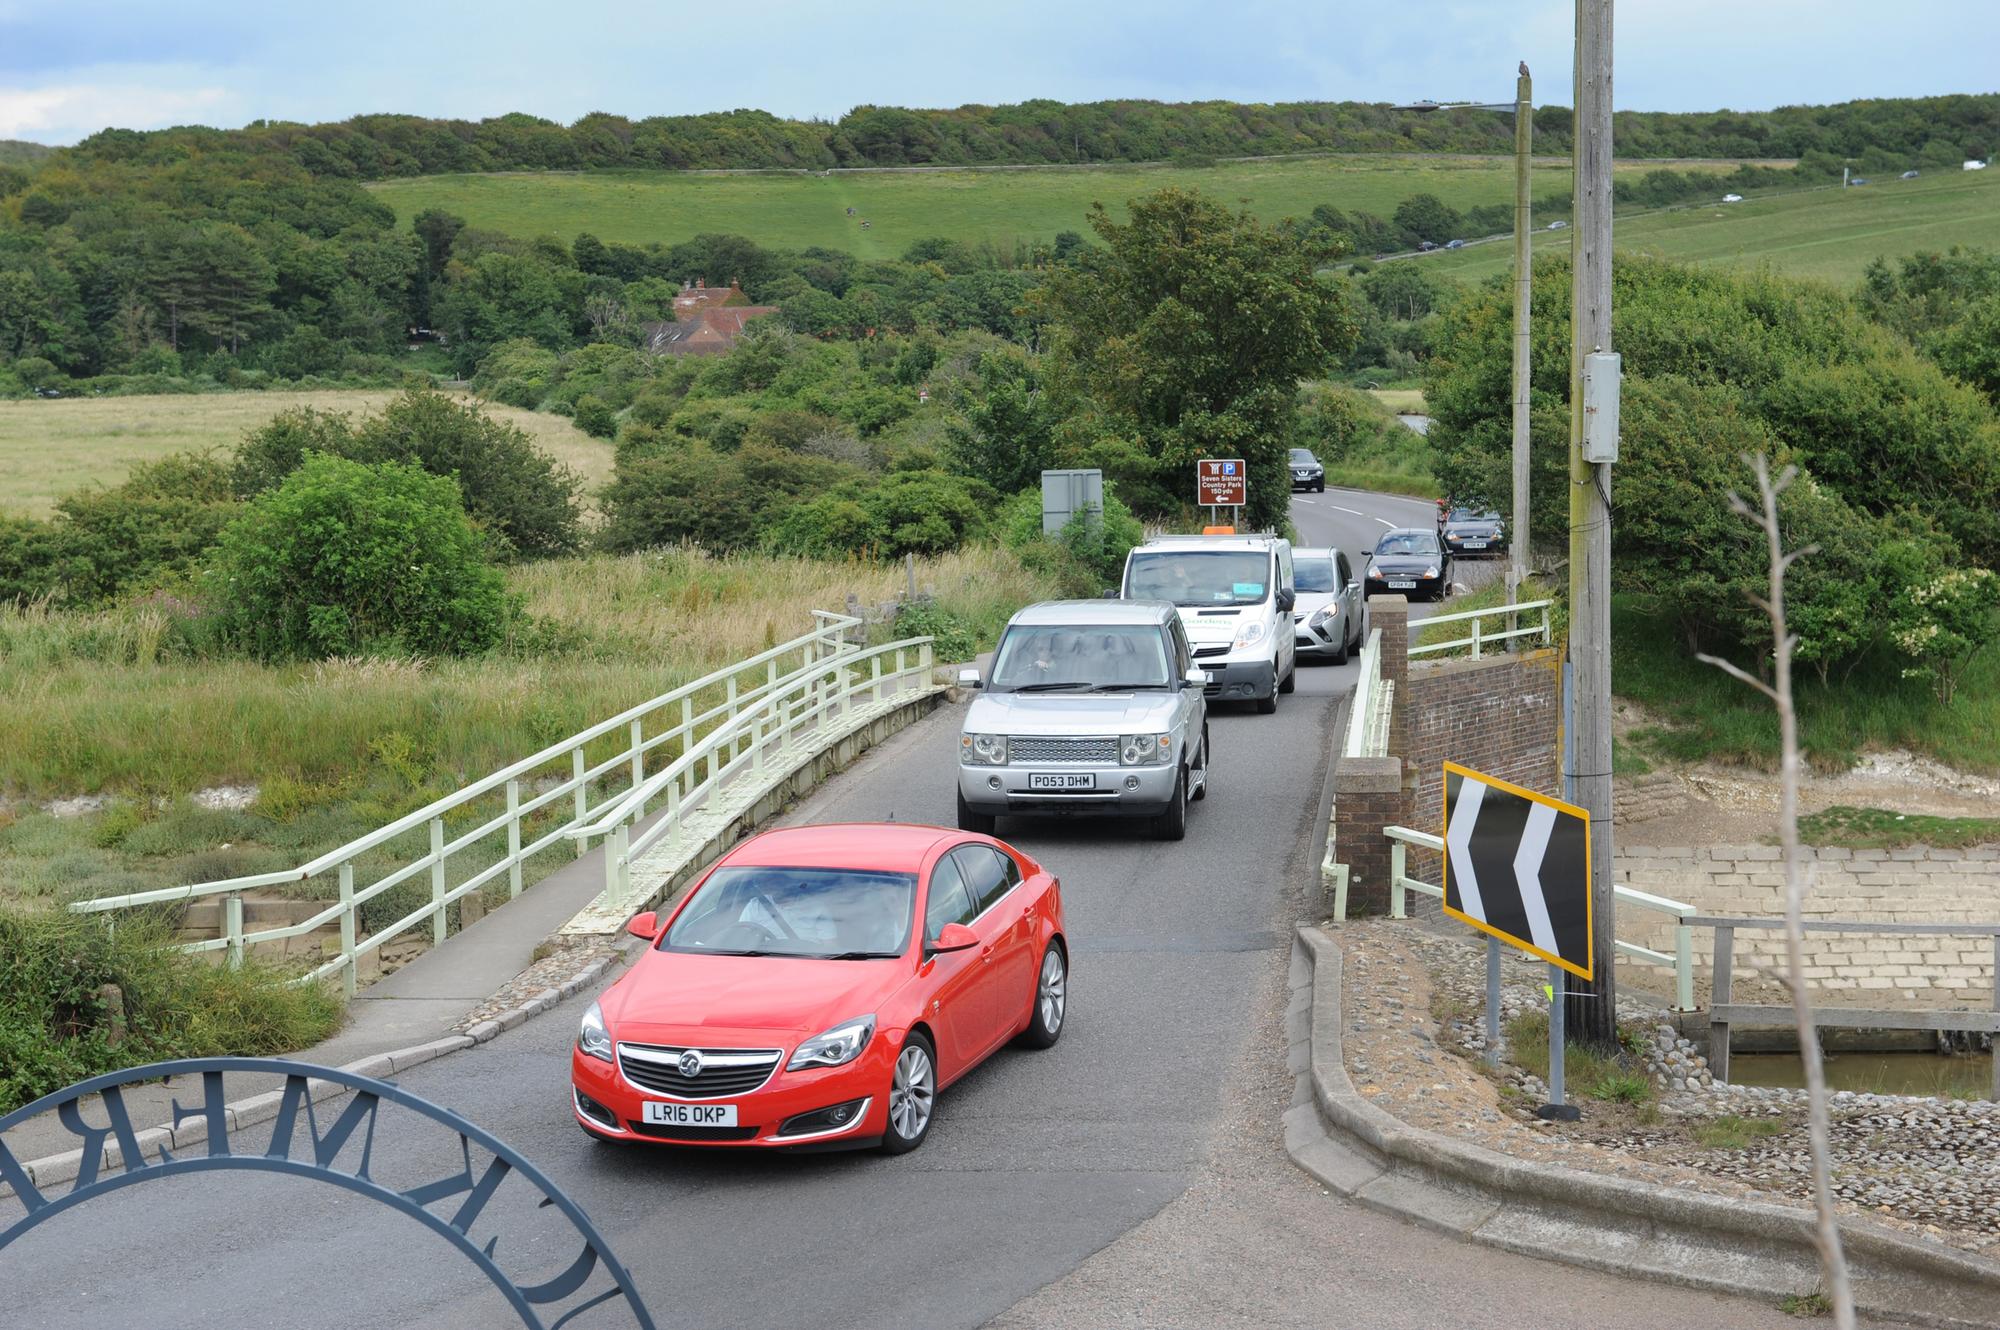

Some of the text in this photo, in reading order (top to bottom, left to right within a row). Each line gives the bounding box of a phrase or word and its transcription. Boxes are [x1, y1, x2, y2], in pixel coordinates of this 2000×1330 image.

[1226, 464, 1233, 473] P
[1035, 776, 1090, 787] PO53 DHM
[653, 1104, 726, 1123] LR16 OKP
